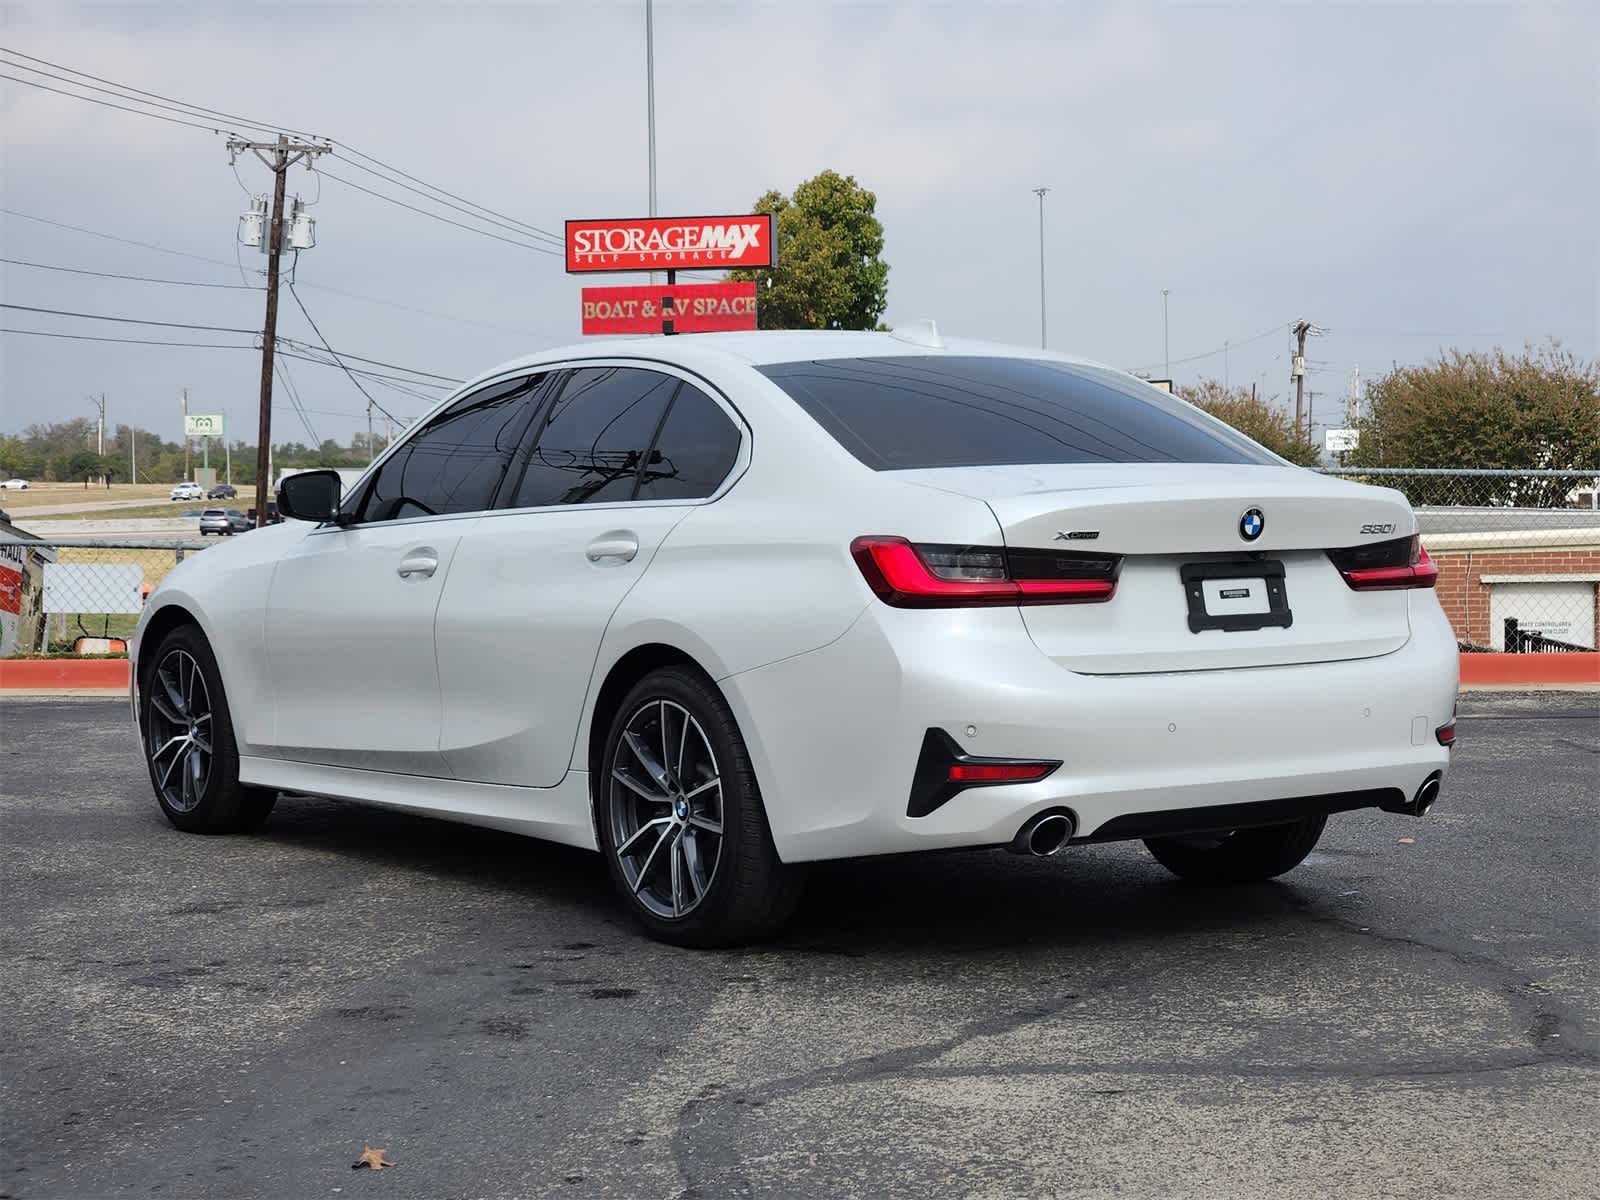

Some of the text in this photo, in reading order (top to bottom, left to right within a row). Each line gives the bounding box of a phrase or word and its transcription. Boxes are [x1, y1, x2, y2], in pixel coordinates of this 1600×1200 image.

[575, 250, 728, 263] SELF STORAGE
[583, 301, 638, 319] BOAT
[641, 300, 656, 318] &
